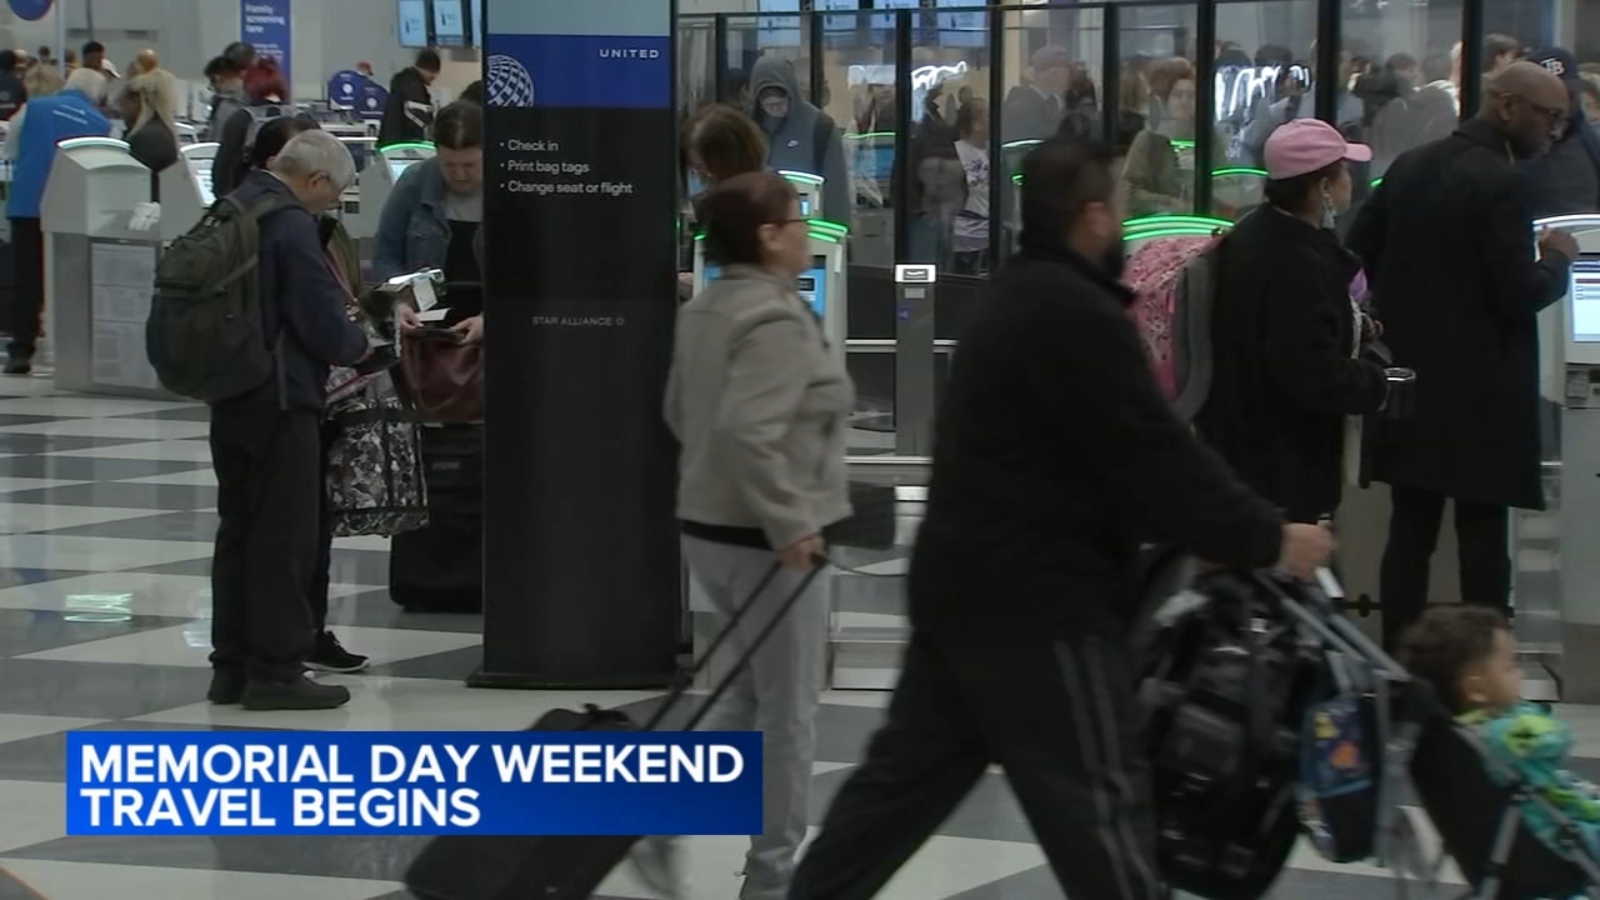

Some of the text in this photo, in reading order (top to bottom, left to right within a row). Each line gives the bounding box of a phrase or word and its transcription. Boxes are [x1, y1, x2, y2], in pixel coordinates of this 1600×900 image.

[599, 49, 660, 58] UNITED
[507, 139, 559, 151] Check in
[507, 159, 591, 175] Print bag tags
[508, 180, 633, 196] Change seat or flight
[532, 316, 613, 326] STAR ALLIANCE
